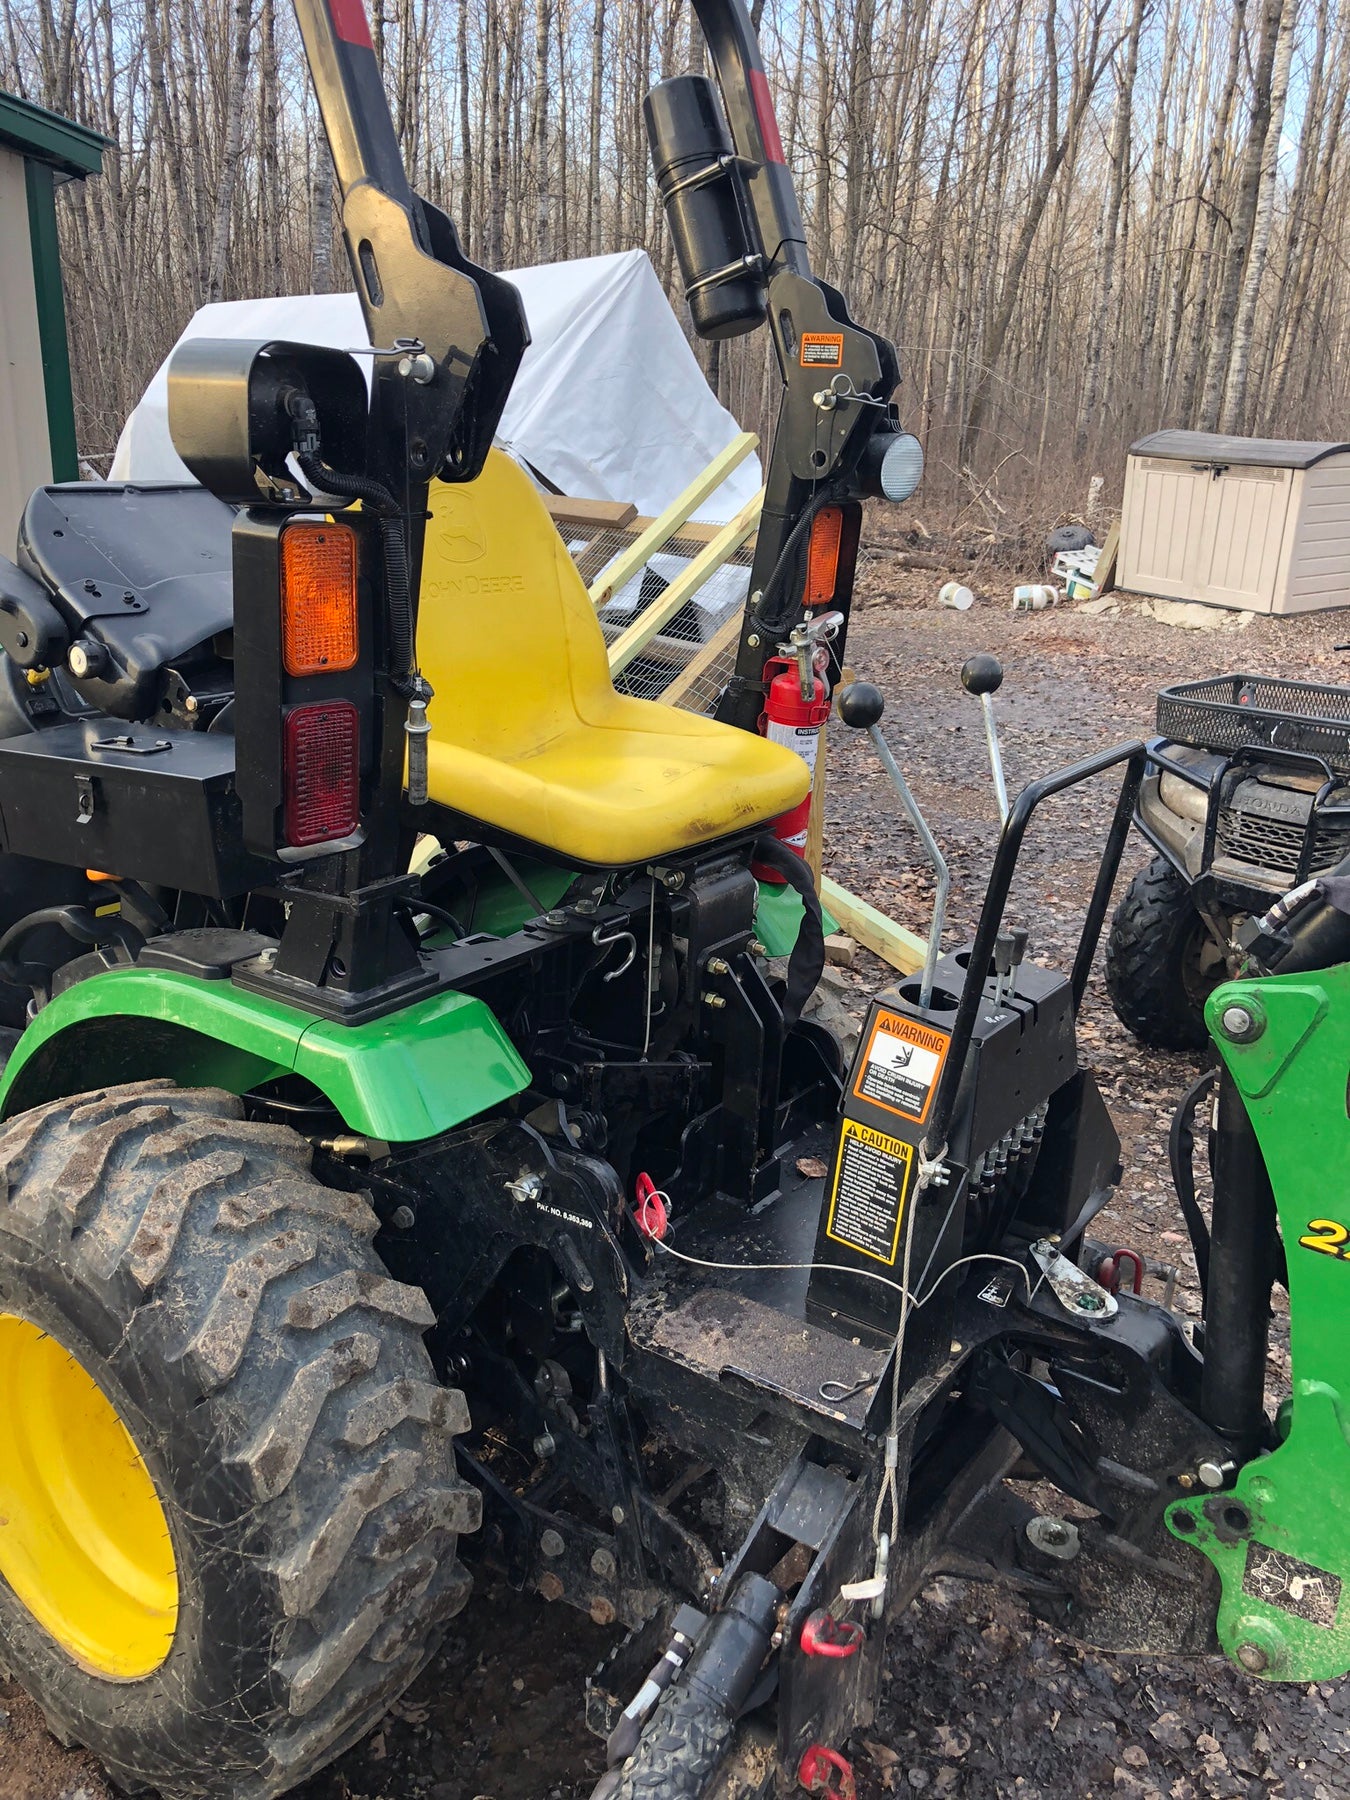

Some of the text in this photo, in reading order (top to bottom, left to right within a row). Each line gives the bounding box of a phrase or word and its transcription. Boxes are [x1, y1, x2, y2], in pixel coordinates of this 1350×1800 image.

[465, 575, 524, 594] DEERE
[1239, 795, 1304, 818] HONDA
[890, 1020, 944, 1051] WARNING
[868, 1068, 895, 1083] OR DEATH
[869, 1063, 925, 1090] AVOID CRUSH INJURY
[849, 1138, 902, 1165] HELP AVOID INJURY
[860, 1128, 908, 1158] CAUTION
[536, 1202, 550, 1212] PAT.
[550, 1207, 562, 1217] NO.
[1298, 1218, 1350, 1261] 2
